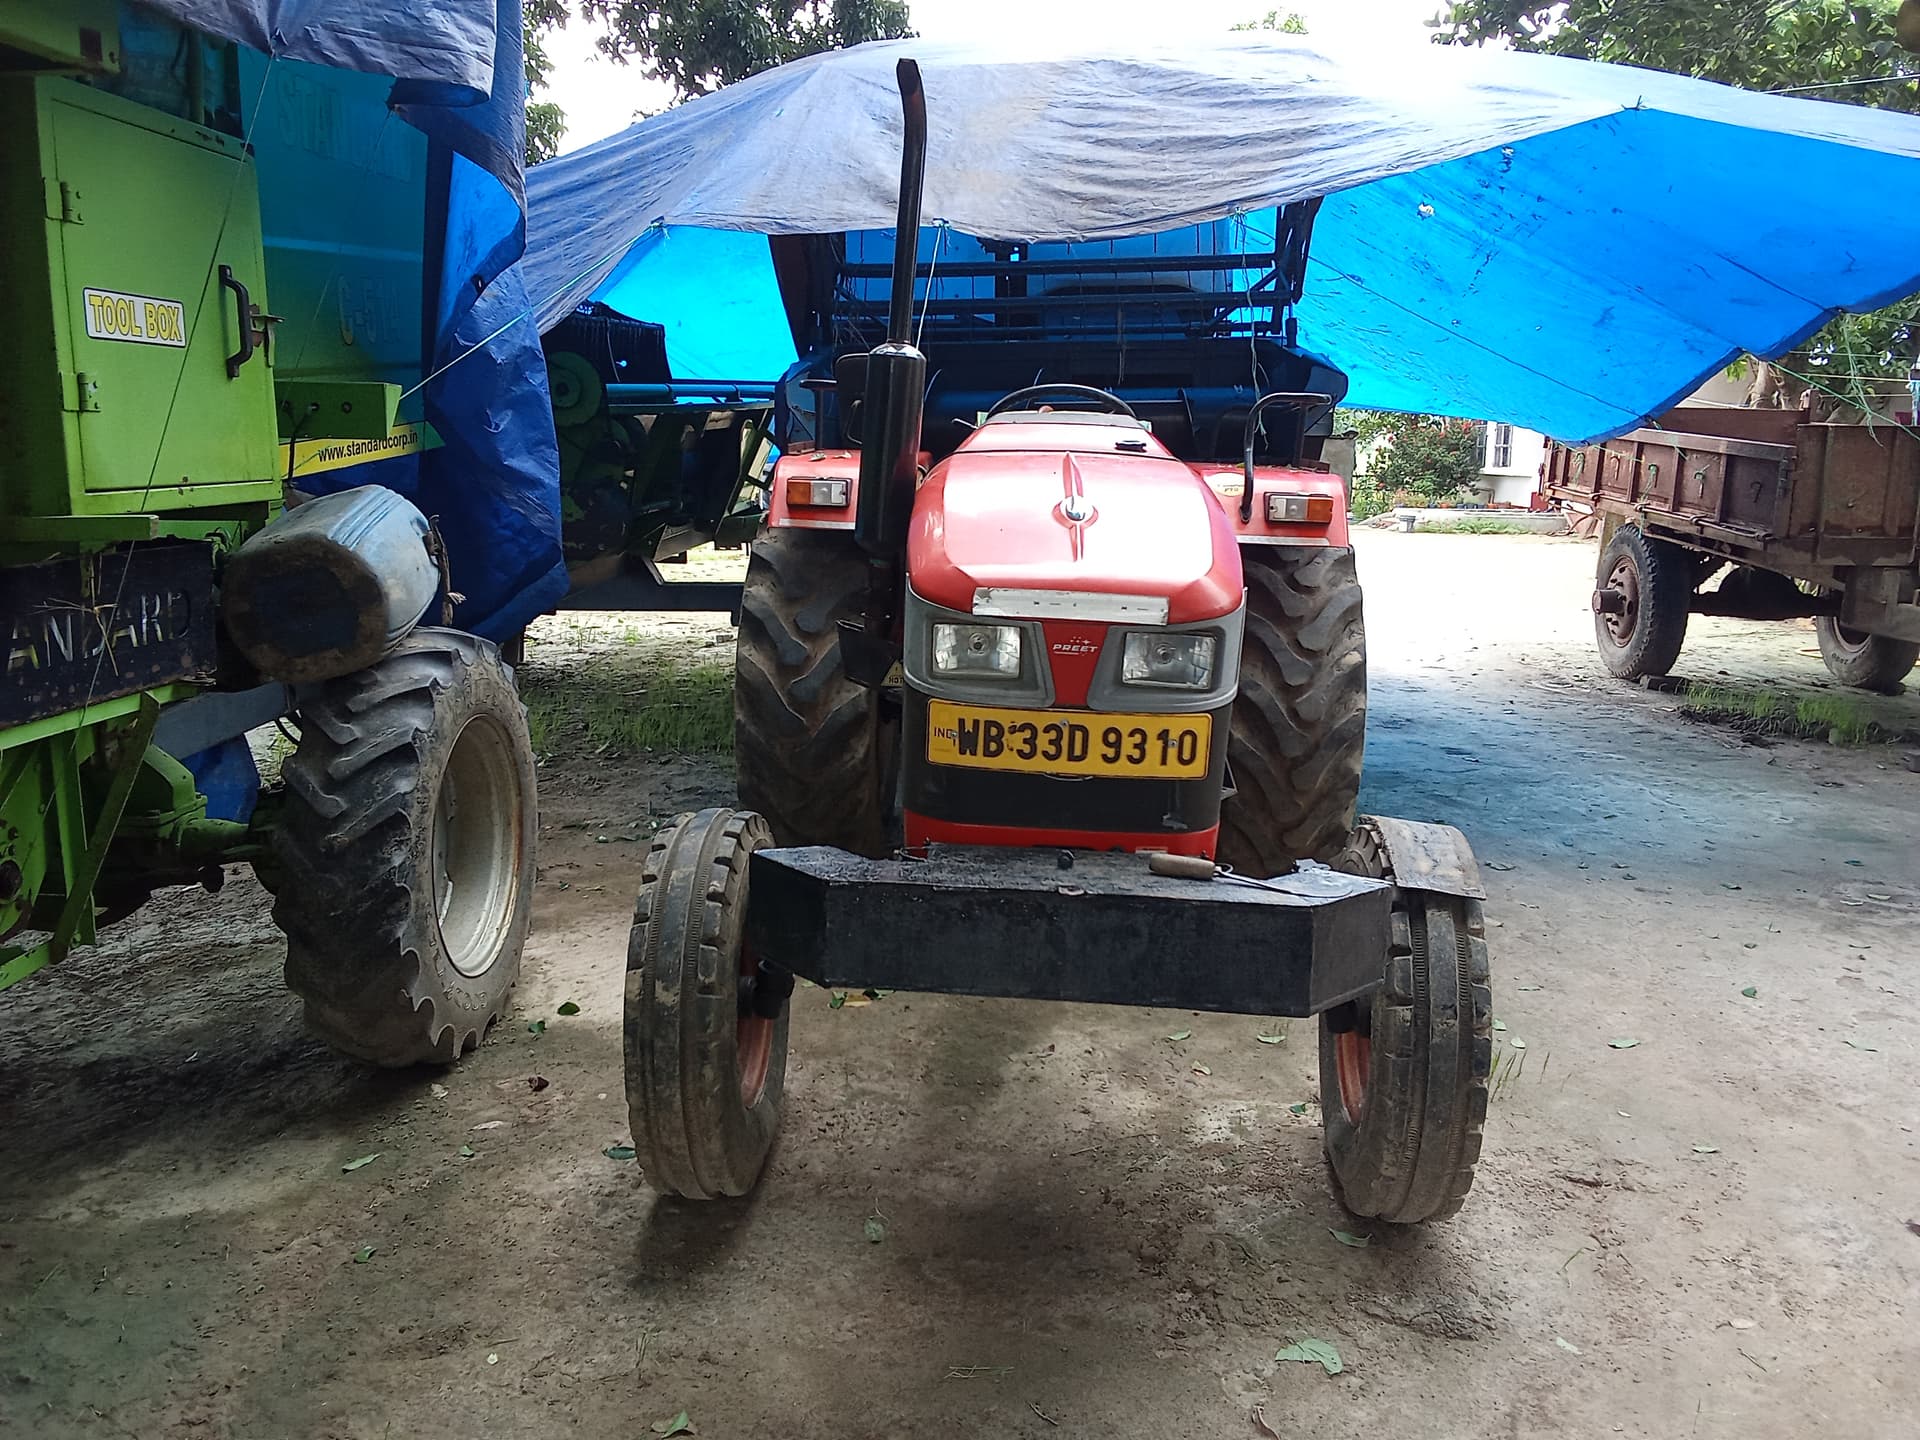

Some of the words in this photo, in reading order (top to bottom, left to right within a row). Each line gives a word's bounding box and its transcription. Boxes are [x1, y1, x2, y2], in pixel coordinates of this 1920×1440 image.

[88, 294, 142, 337] TOOL
[144, 302, 183, 342] BOX
[318, 429, 418, 463] www.standardcorp.in
[1052, 643, 1099, 653] PREET
[1101, 726, 1198, 766] 9310
